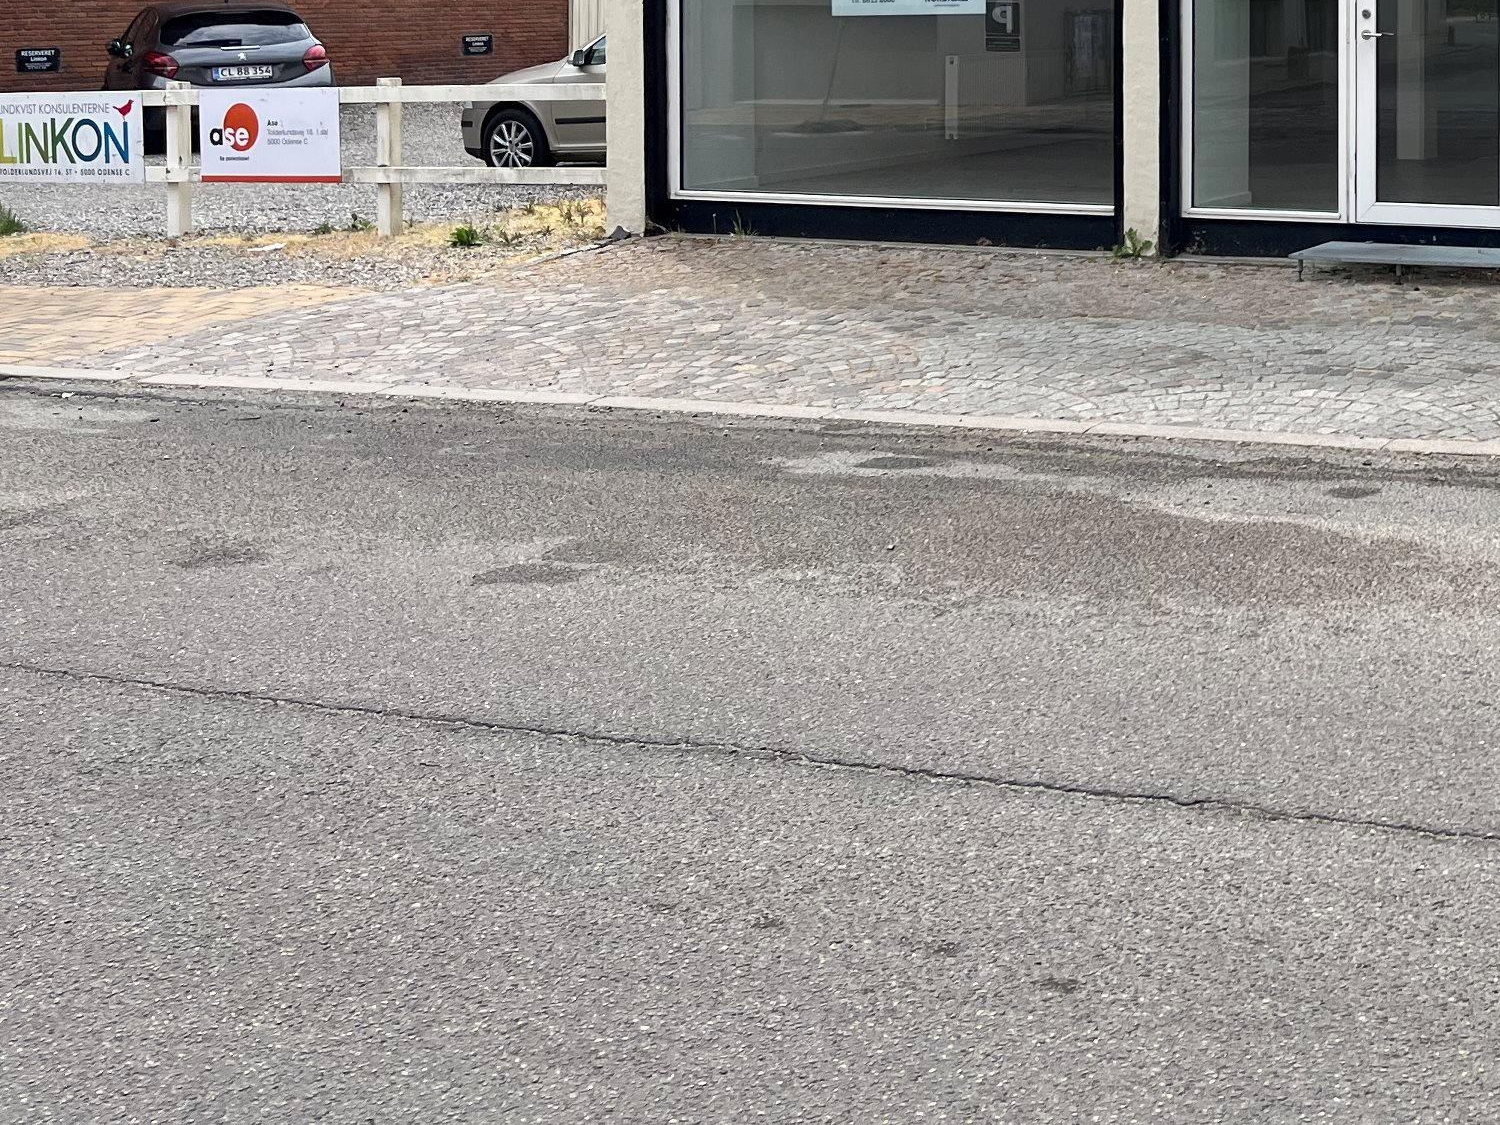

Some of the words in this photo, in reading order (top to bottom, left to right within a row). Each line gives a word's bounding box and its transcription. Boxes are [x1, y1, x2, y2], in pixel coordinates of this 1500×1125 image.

[220, 68, 234, 76] CL
[252, 66, 271, 75] 354
[0, 104, 36, 115] INDKVIST
[39, 103, 110, 115] KONSULENTERNE
[266, 119, 278, 127] Ase
[0, 117, 129, 164] LINKON
[209, 127, 250, 147] ase
[303, 137, 308, 145] C
[97, 168, 123, 176] ODENSE
[125, 168, 130, 176] C
